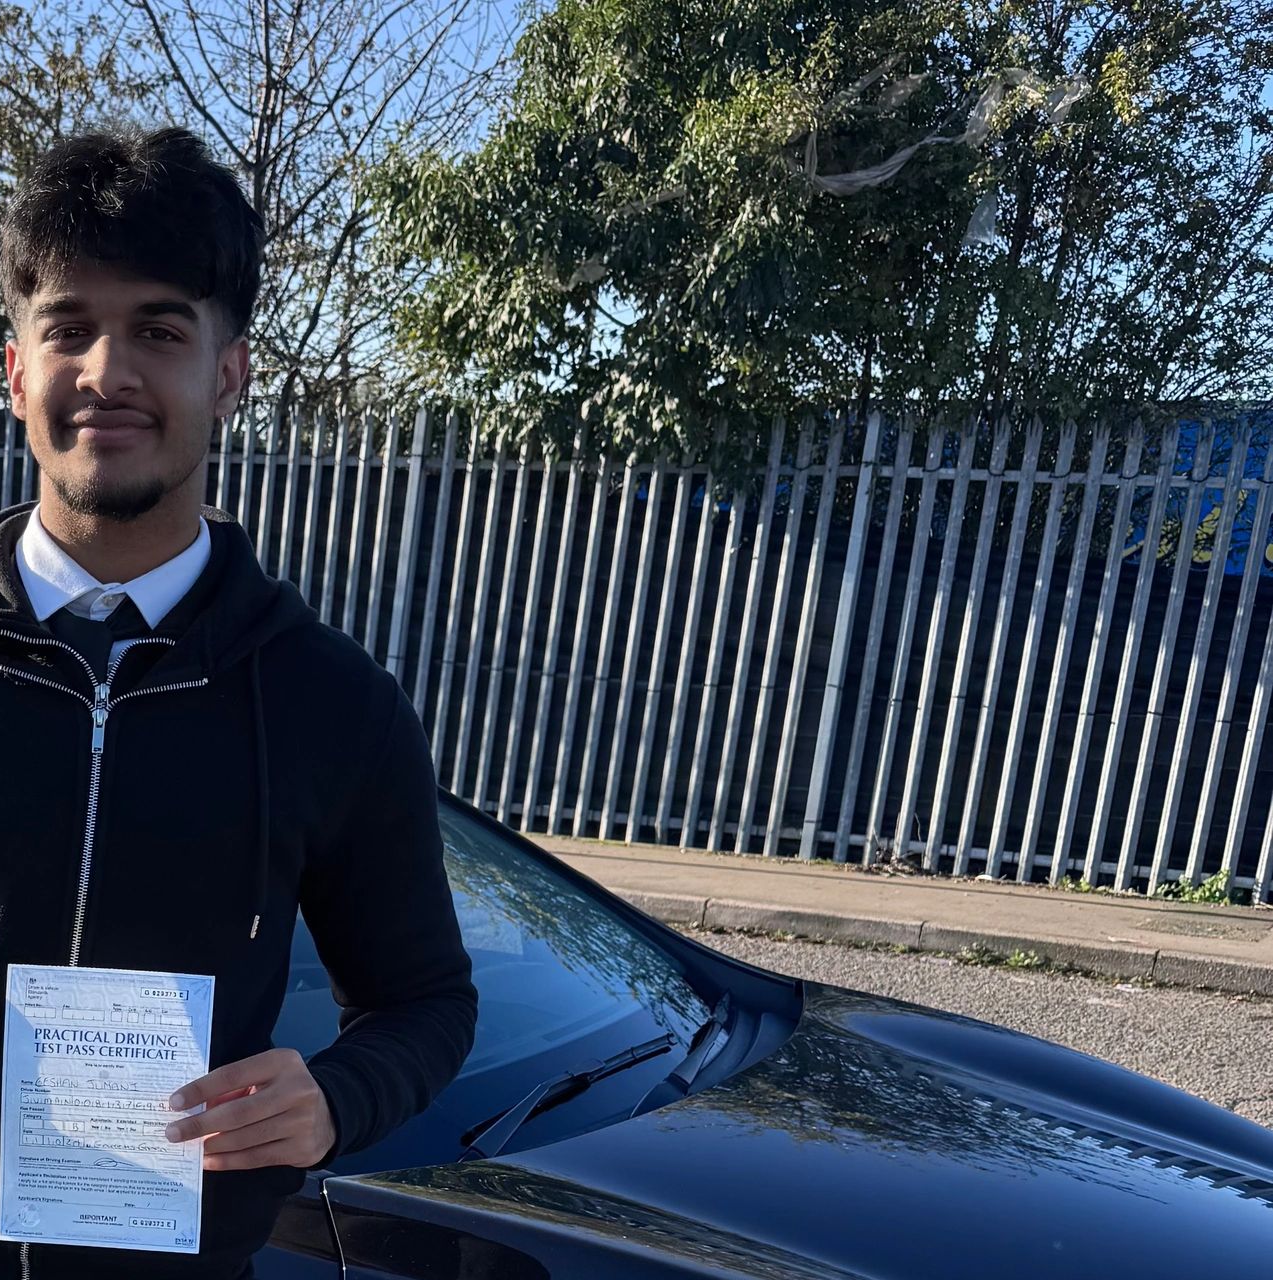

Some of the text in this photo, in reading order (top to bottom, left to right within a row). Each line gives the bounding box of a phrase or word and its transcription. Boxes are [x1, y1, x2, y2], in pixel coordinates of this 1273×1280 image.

[34, 1028, 178, 1048] PRACTICAL DRIVING
[34, 1042, 177, 1061] TEST PASS CERTIFICATE
